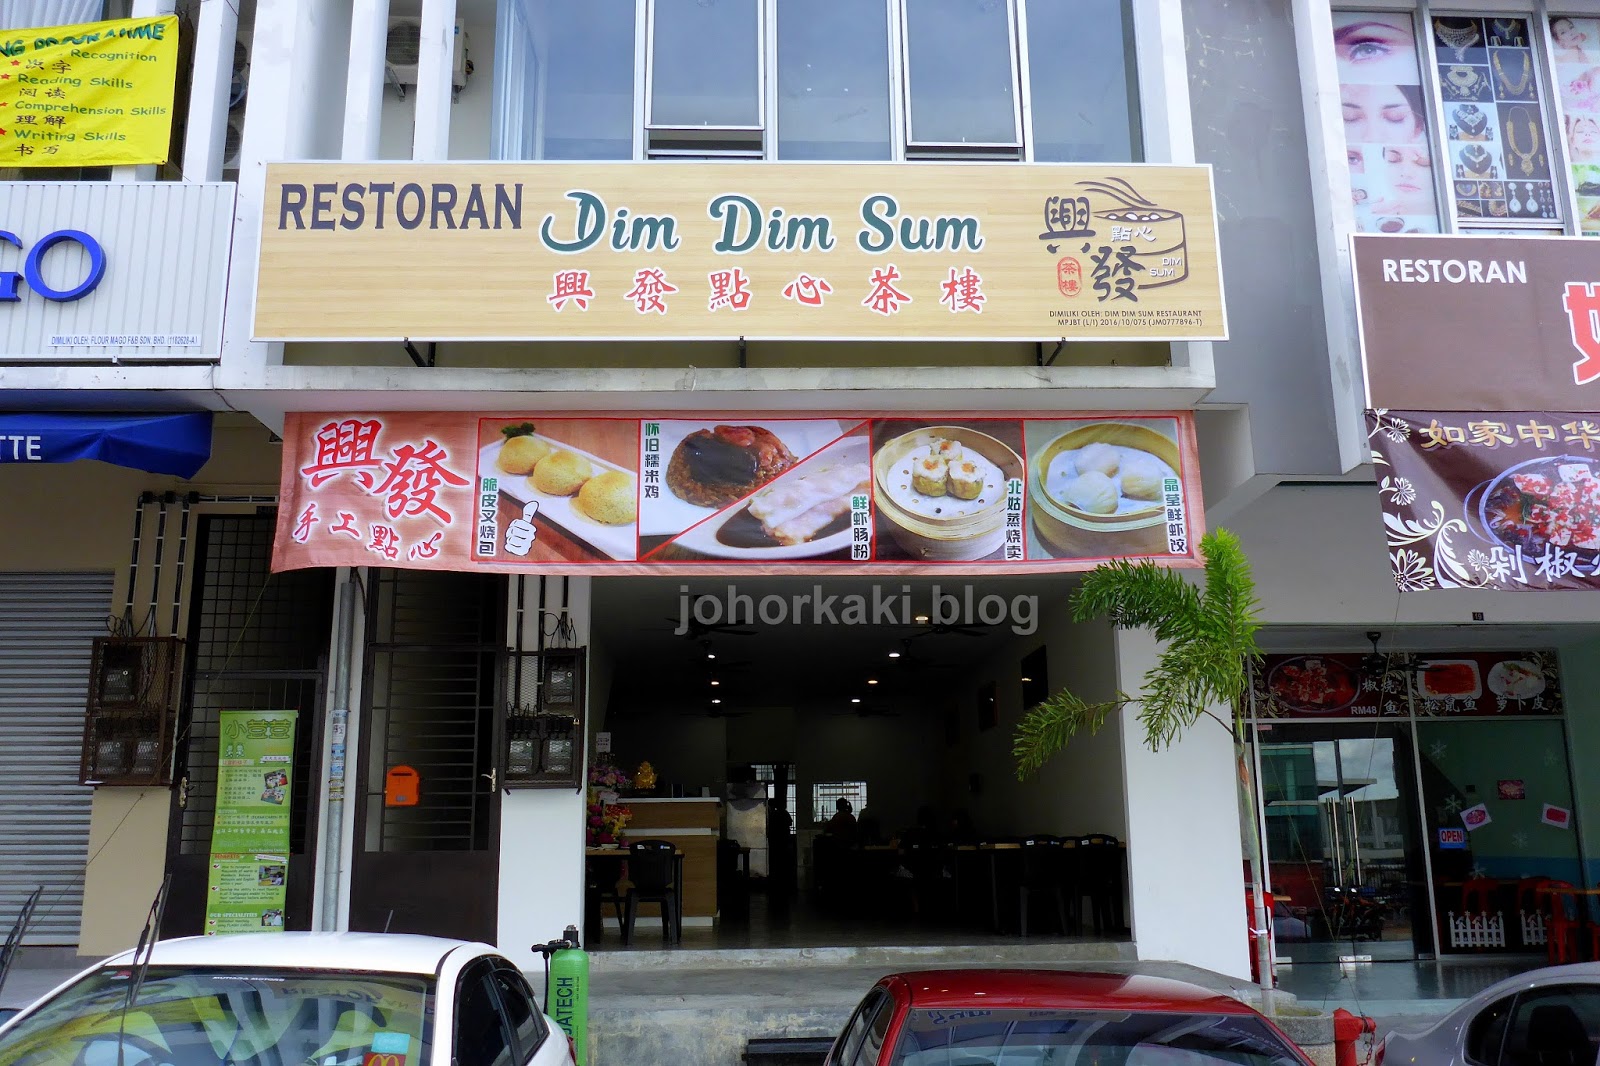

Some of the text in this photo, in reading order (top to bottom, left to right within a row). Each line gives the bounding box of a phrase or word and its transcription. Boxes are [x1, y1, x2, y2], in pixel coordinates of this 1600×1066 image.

[70, 48, 158, 63] Recognition
[18, 73, 134, 89] Reading Skills
[15, 100, 167, 116] Comprehension Skills
[14, 129, 127, 142] Writing Skills
[278, 182, 524, 232] RESTORAN
[540, 190, 983, 254] Dim Dim Sum
[1162, 257, 1183, 267] DIM
[1150, 268, 1175, 277] SUM
[1382, 258, 1527, 284] RESTORAN
[1049, 310, 1079, 318] DIMILIKI
[1100, 319, 1147, 327] 2016/10/075
[479, 476, 499, 556] 脆皮叉烧包
[852, 495, 869, 560] 鲜虾肠粉
[1351, 706, 1377, 715] RM48
[1440, 830, 1463, 844] OPEN
